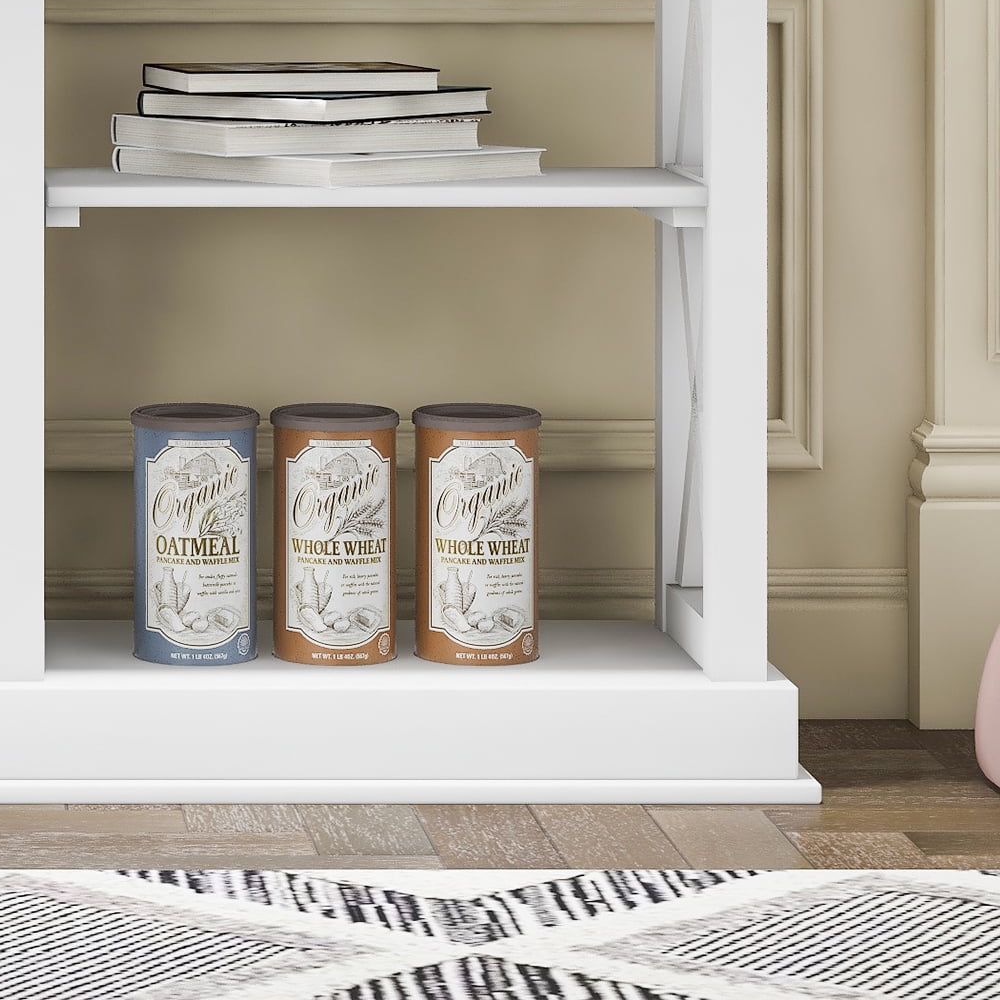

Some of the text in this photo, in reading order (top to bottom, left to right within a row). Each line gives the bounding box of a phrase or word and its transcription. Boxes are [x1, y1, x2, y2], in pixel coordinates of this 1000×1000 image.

[153, 463, 239, 534] Organic
[293, 463, 380, 533] Organic
[437, 463, 524, 534] Organic
[156, 535, 240, 556] OATMEAL
[292, 537, 387, 556] WHOLE WHEAT
[435, 537, 530, 556] WHOLE WHEAT
[156, 557, 240, 565] PANCAKE AND WAFFLE MIX
[297, 557, 382, 565] PANCAKE AND WAFFLE MIX
[440, 557, 525, 565] PANCAKE AND WAFFLE MIX
